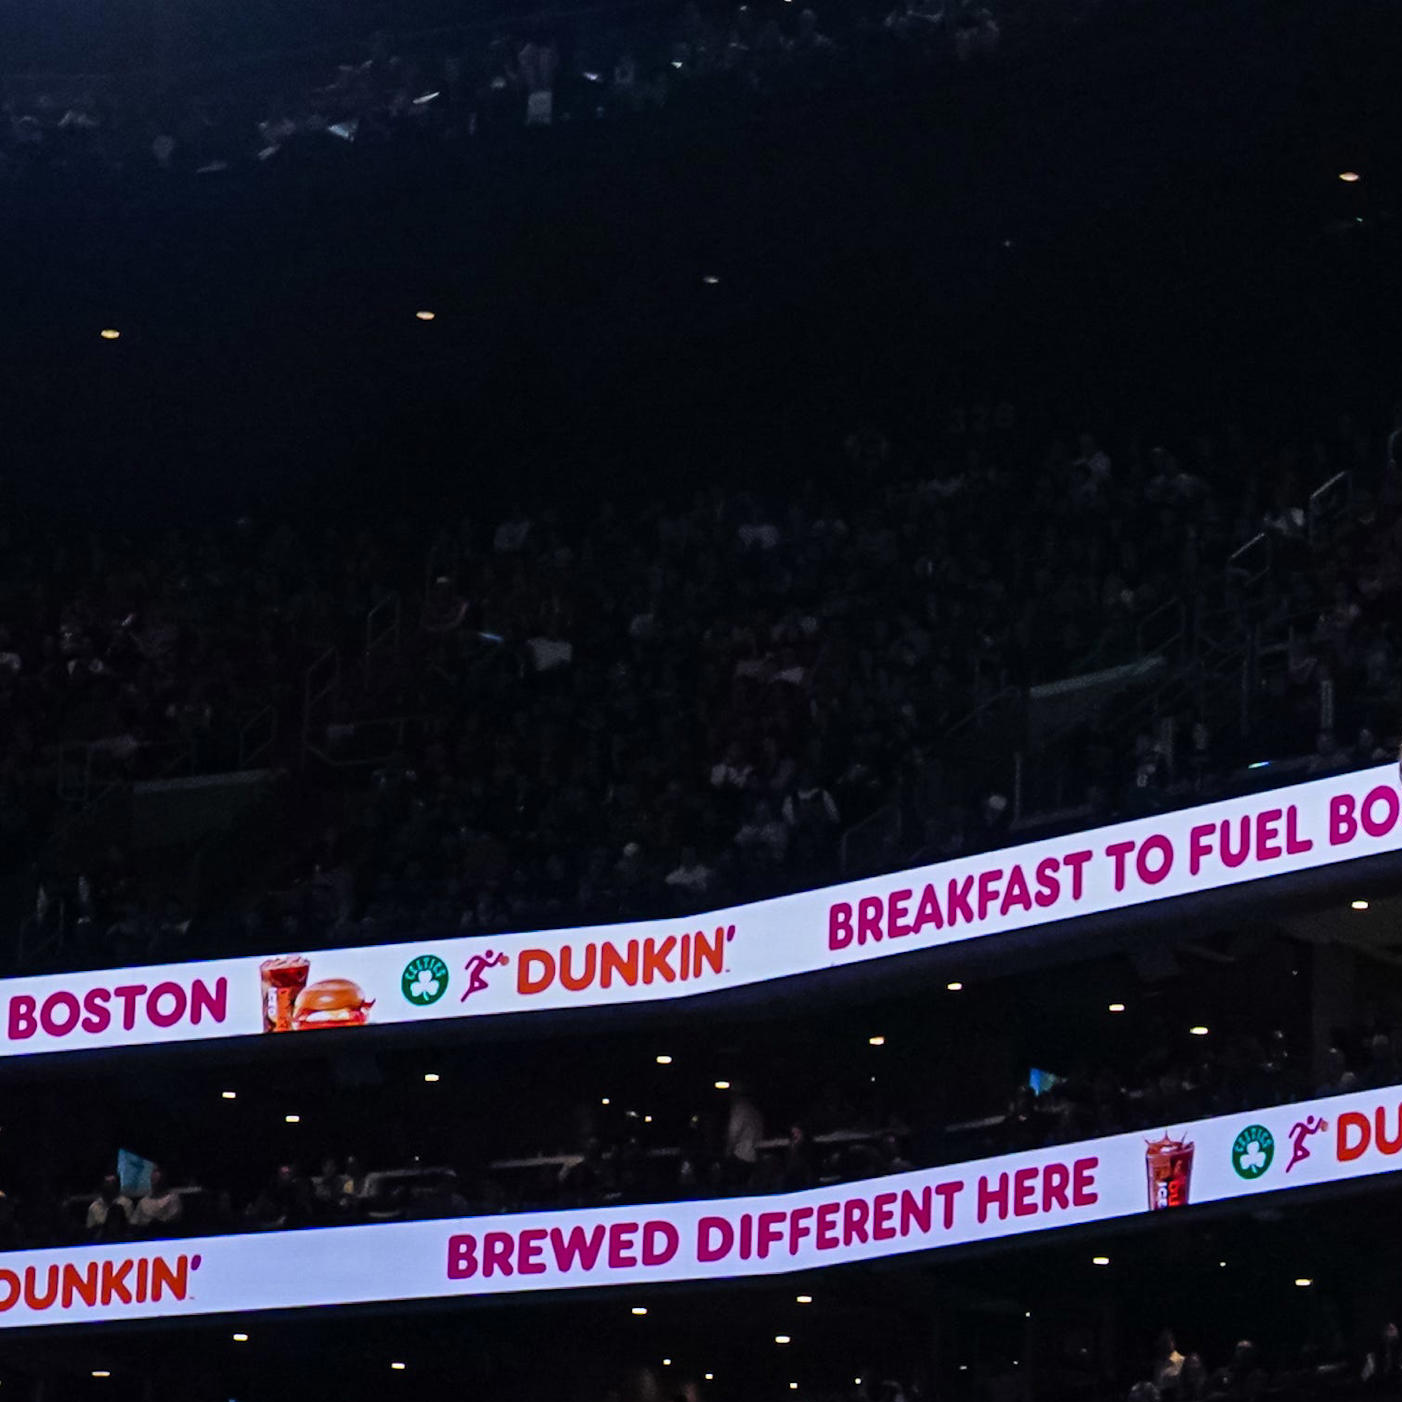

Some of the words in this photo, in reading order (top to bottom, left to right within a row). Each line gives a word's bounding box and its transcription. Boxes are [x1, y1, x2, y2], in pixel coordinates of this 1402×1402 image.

[829, 851, 1092, 950] BREAKFAST
[1106, 835, 1173, 891] TO
[1191, 806, 1312, 875] FUEL
[407, 955, 446, 980] CELTICS
[518, 926, 735, 994] DUNKIN'
[8, 978, 227, 1040] BOSTON
[448, 1221, 679, 1278] BREWED
[697, 1181, 963, 1262] DIFFERENT
[978, 1157, 1098, 1223] HERE
